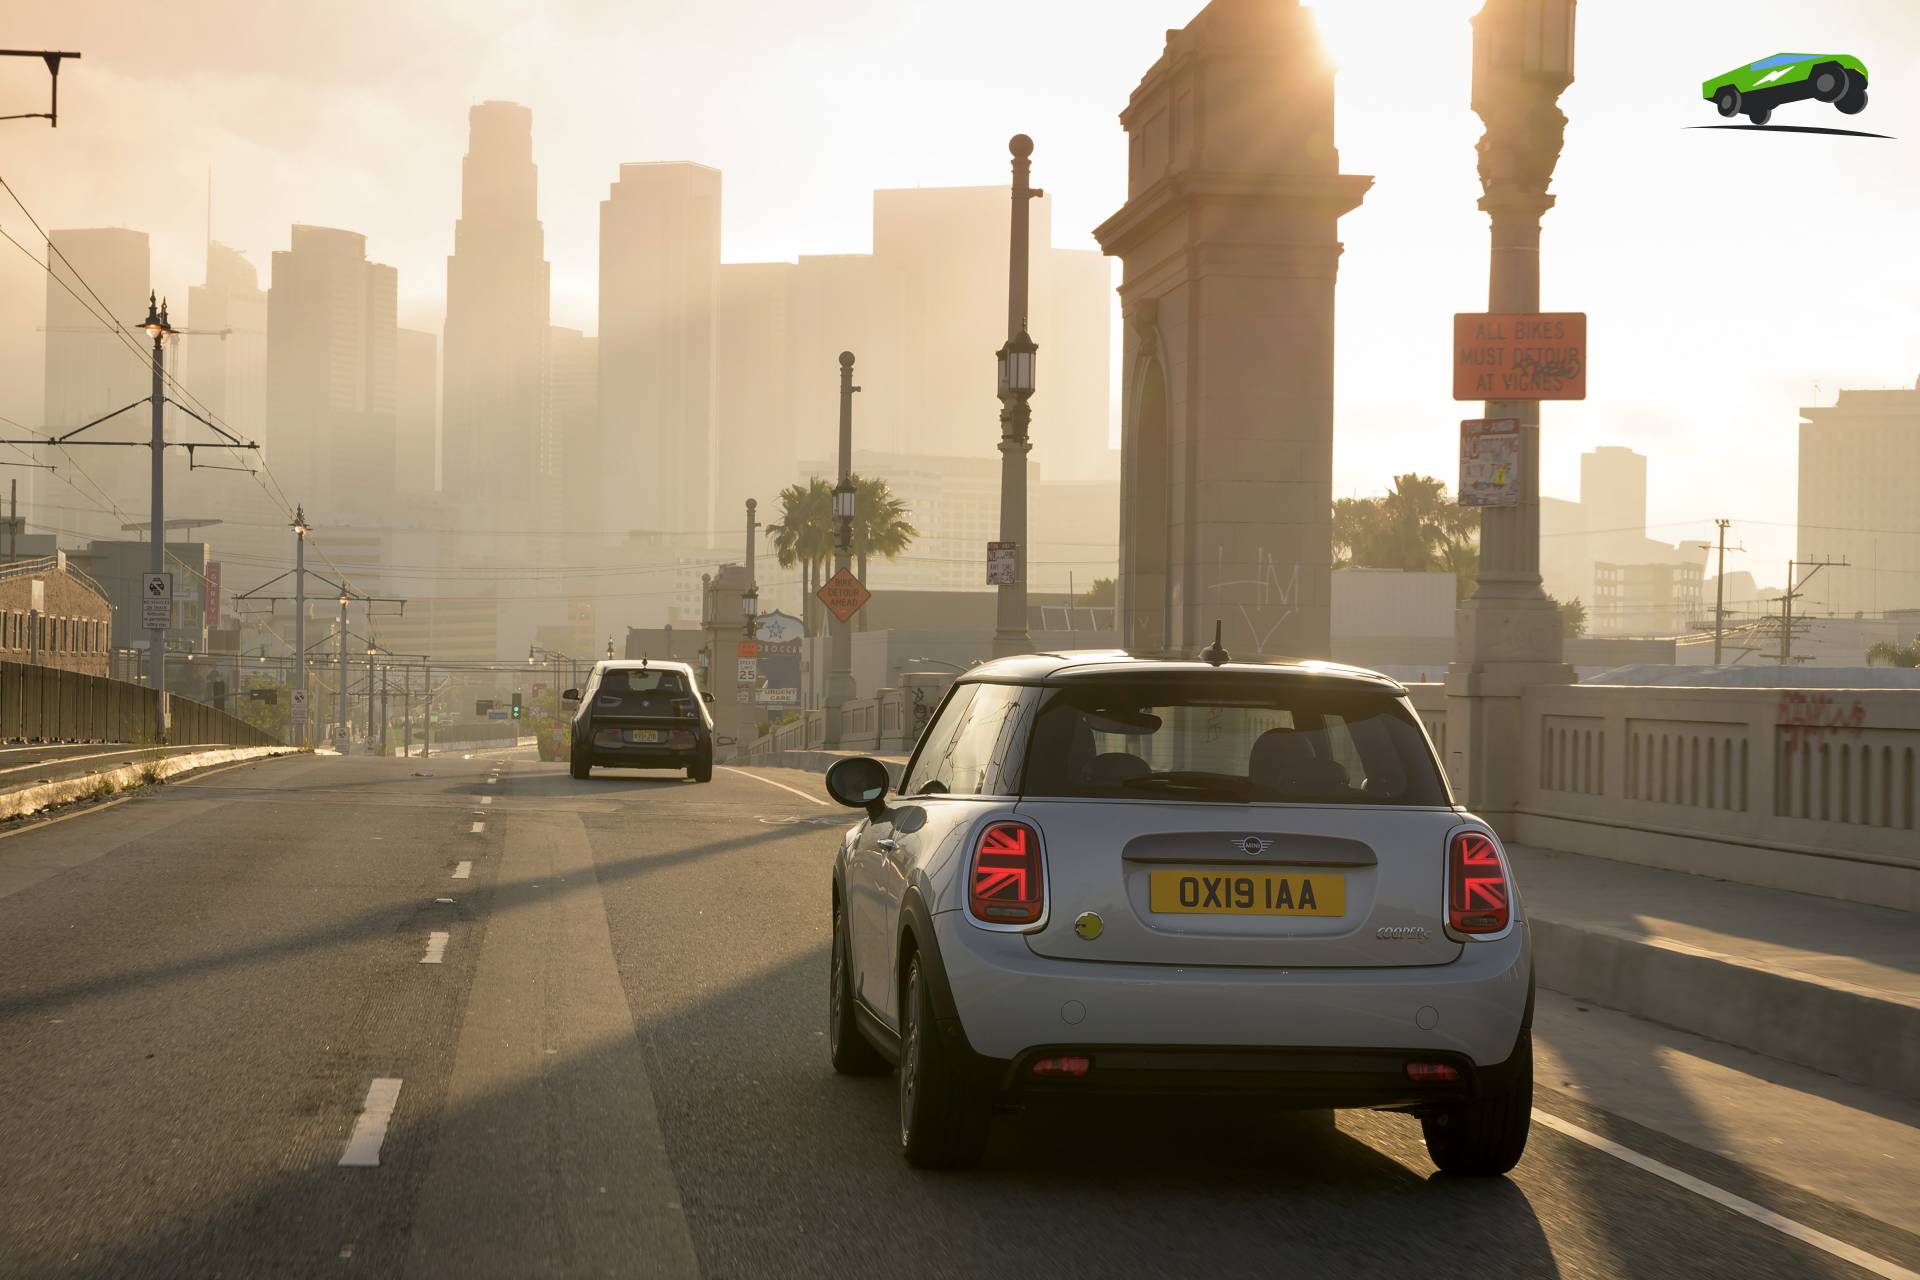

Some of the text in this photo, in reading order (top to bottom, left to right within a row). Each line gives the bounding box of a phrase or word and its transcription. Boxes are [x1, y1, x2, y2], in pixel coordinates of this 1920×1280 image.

[1475, 321, 1565, 340] ALL BIKES
[1461, 346, 1579, 366] MUST DETOUR
[1476, 373, 1564, 392] AT VIGNES
[827, 589, 860, 597] DETOUR
[830, 599, 858, 607] AHEAD
[739, 670, 755, 680] 25
[1179, 876, 1254, 909] OX19
[1376, 927, 1425, 940] COOPER
